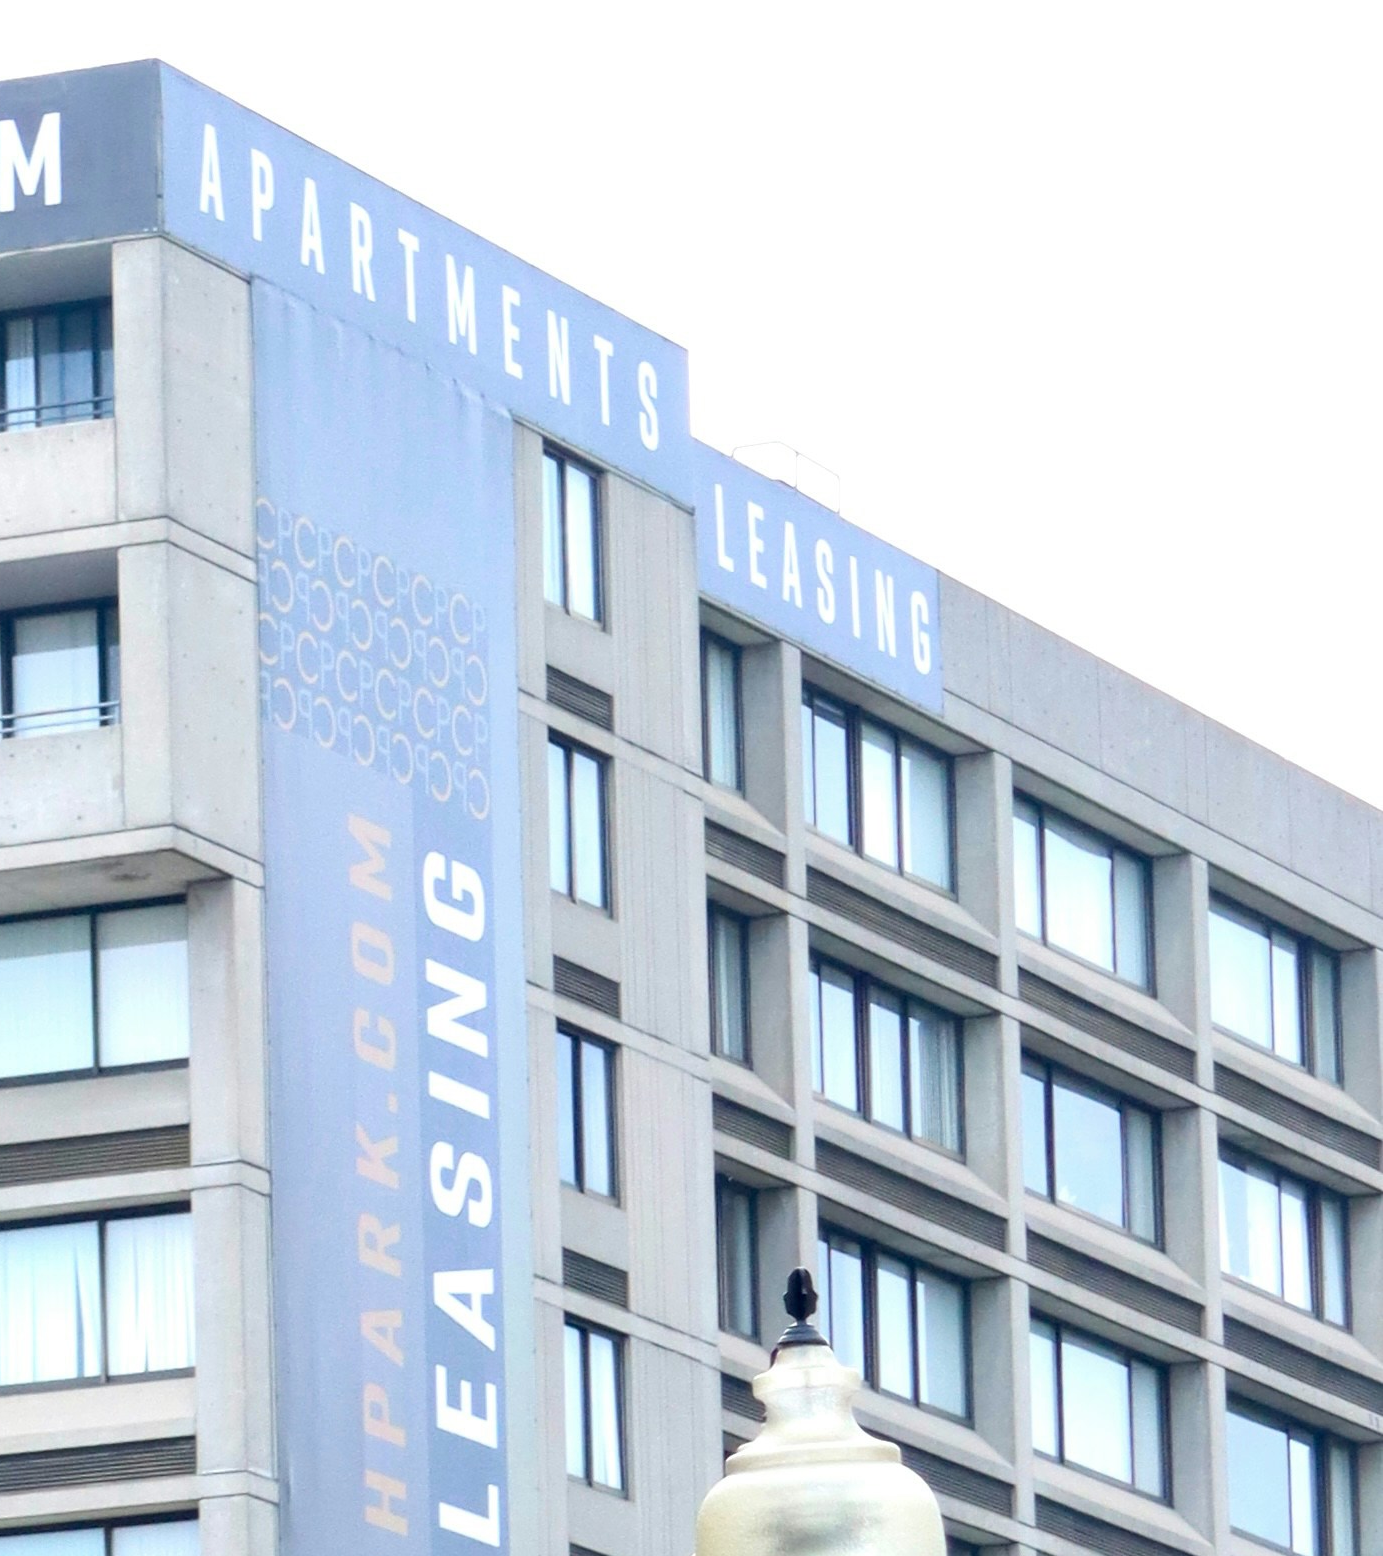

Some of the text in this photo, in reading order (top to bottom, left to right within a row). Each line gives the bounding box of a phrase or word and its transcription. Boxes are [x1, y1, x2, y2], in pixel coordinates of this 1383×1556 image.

[199, 123, 660, 452] APARTMENTS
[714, 483, 931, 675] LEASING
[421, 848, 502, 1547] LEASING
